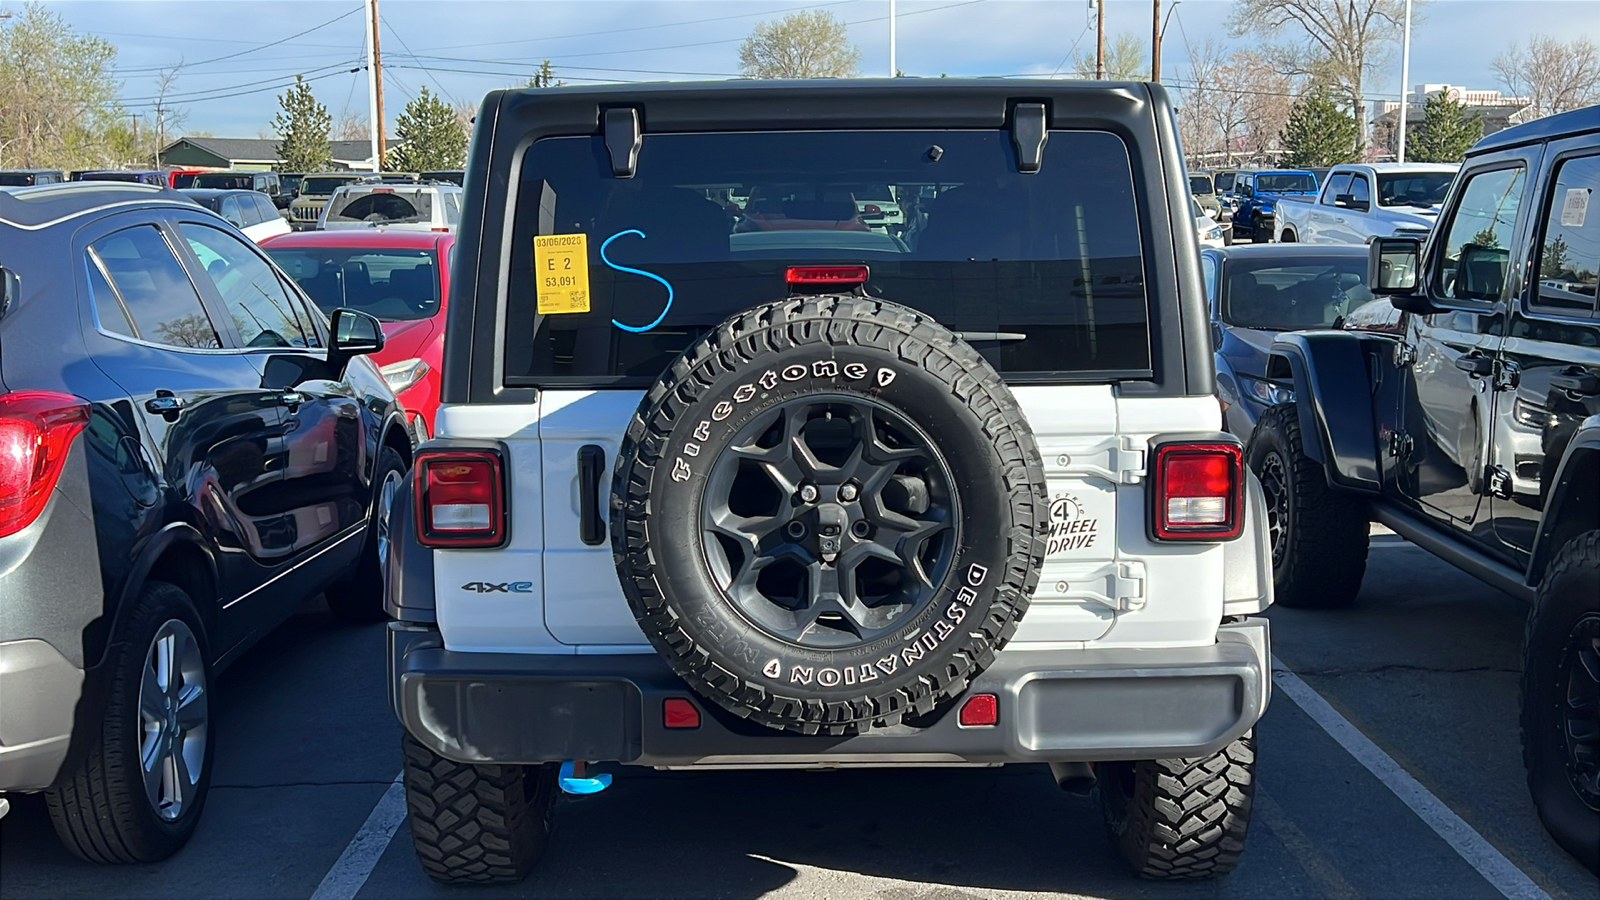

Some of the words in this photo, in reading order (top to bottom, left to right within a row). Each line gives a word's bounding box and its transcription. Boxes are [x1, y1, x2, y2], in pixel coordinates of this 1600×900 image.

[548, 258, 555, 271] E
[564, 257, 571, 270] 2
[545, 276, 576, 288] 53,091
[600, 229, 673, 332] S
[671, 360, 868, 483] Firestone
[1053, 502, 1069, 520] 4
[1047, 519, 1097, 538] WHEEL
[1046, 534, 1096, 555] DRIVE
[790, 563, 988, 687] DESTINATION
